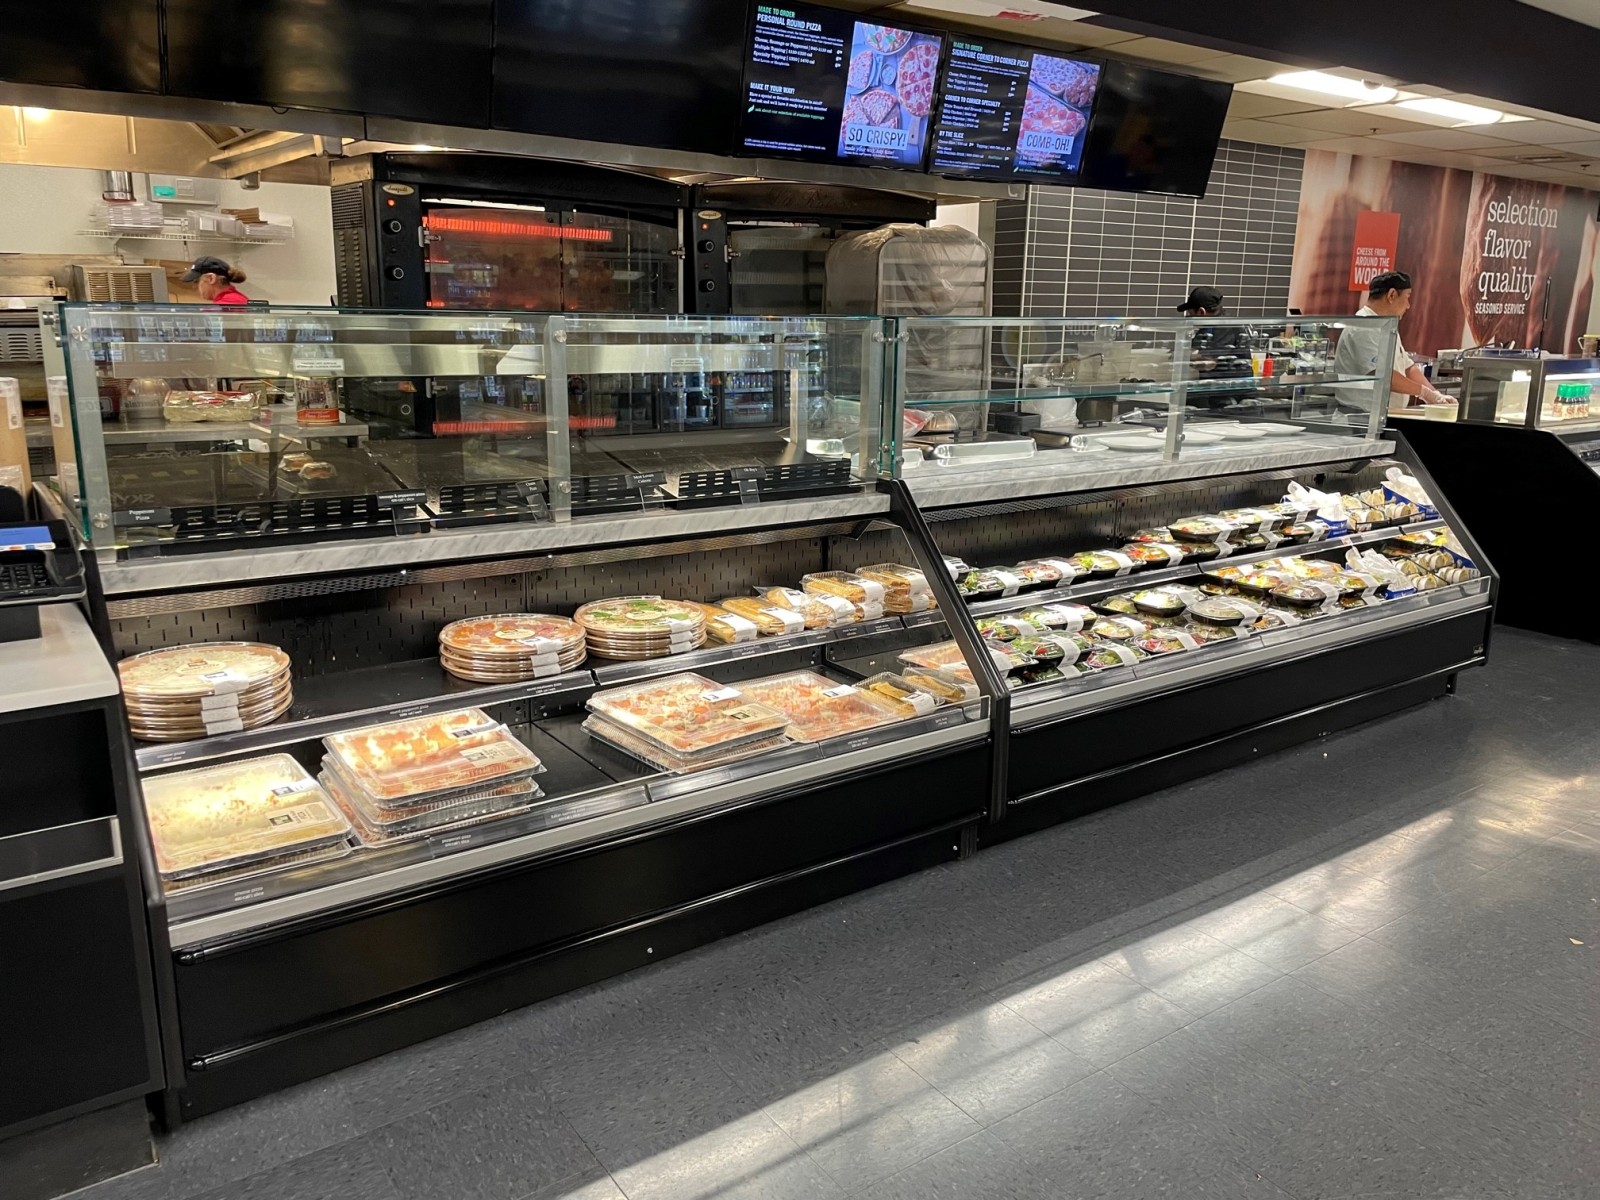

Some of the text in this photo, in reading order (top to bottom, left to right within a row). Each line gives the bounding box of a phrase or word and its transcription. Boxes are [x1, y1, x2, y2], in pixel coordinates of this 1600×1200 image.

[758, 5, 795, 18] MADE TO ORDER
[757, 14, 821, 32] PERSONAL ROUND PIZZA
[952, 48, 976, 59] SIGNATURE
[977, 53, 994, 62] CORNER
[1000, 56, 1016, 65] CORNER
[750, 82, 763, 90] MAKE
[770, 84, 782, 92] YOUR
[848, 127, 906, 147] SO CRISPY!
[1027, 134, 1070, 151] COMB-OH!
[1487, 196, 1558, 228] selection
[1356, 247, 1387, 256] CHEESE FROM
[1482, 228, 1532, 260] flavor
[1355, 256, 1390, 267] AROUND THE
[1354, 267, 1389, 285] WOR
[1478, 265, 1538, 300] quality
[1475, 302, 1525, 315] SEASONED SERVICE
